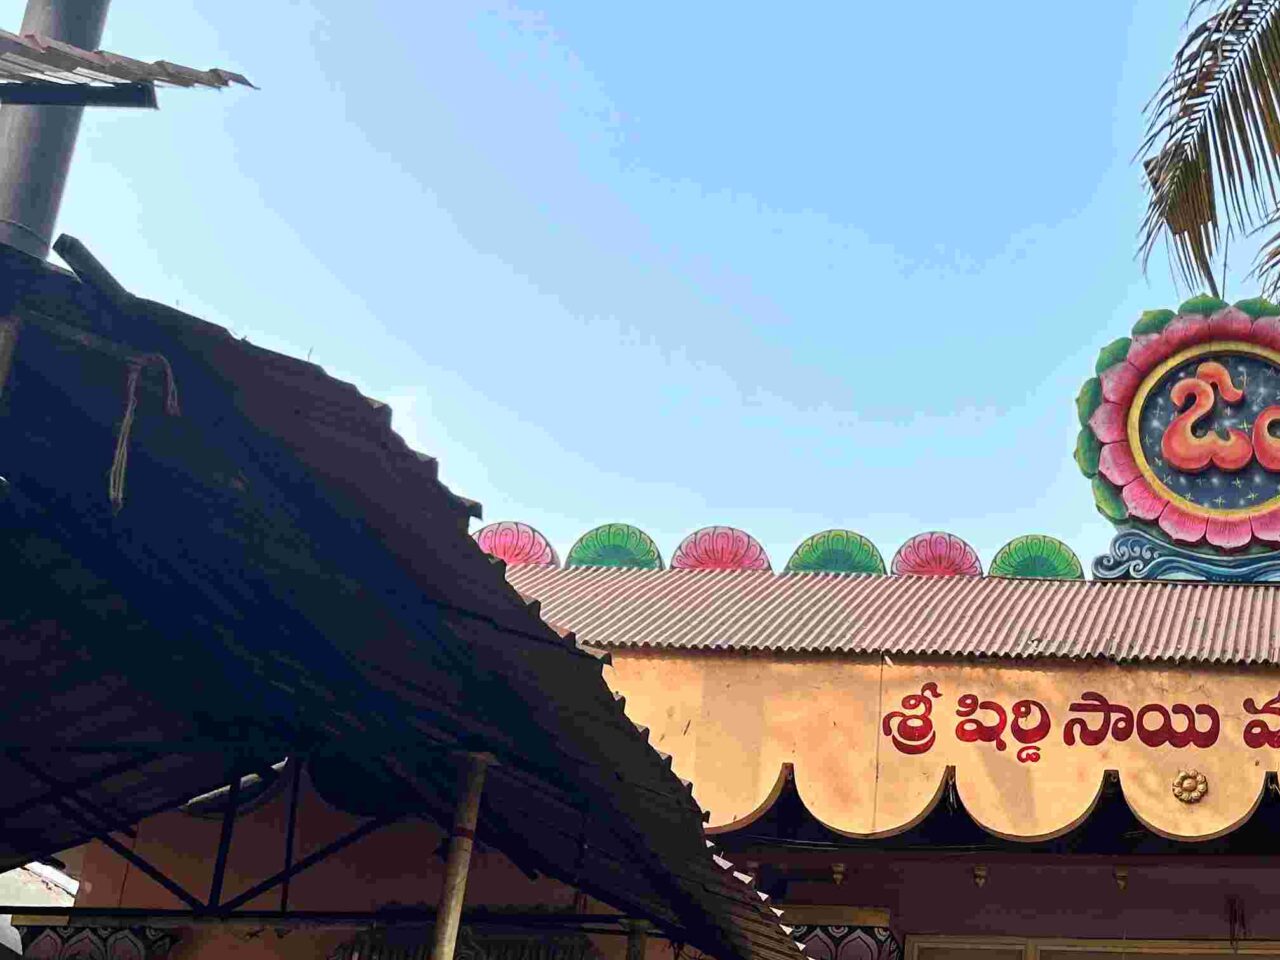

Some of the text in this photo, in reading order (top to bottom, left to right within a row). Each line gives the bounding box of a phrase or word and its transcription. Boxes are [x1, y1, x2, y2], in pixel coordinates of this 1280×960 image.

[882, 681, 943, 755] శ్రీ
[955, 693, 1051, 763] షిర్డి
[1062, 691, 1220, 750] సాయి
